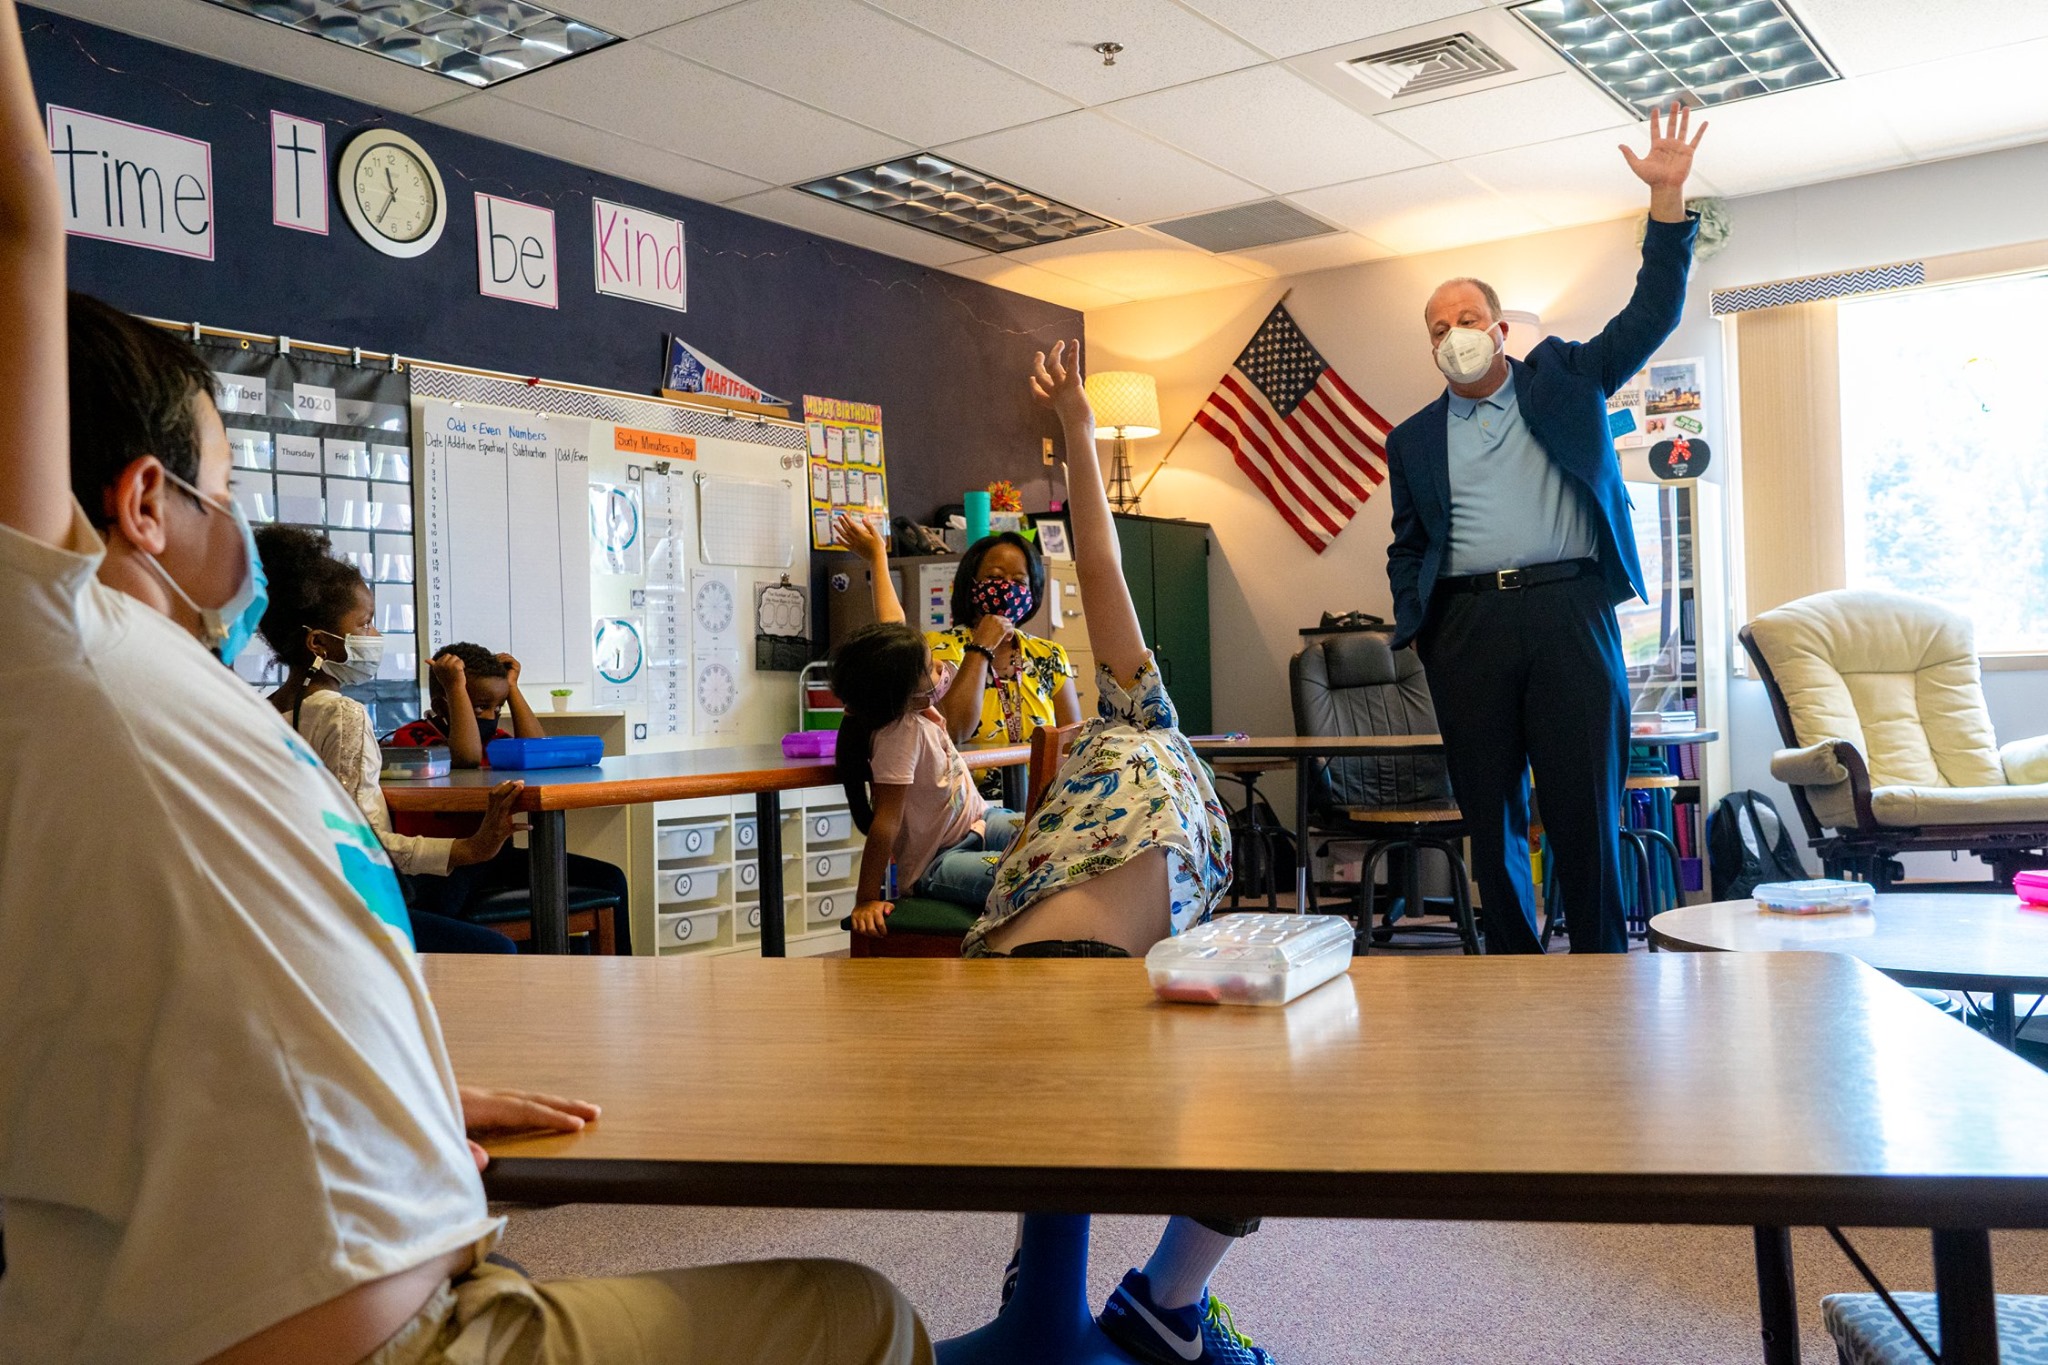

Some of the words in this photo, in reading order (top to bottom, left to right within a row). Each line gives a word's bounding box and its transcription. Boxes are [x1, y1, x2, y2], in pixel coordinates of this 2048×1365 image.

[373, 157, 380, 167] 11
[387, 155, 396, 165] 12
[364, 167, 373, 177] 10
[405, 164, 408, 173] 1
[414, 177, 419, 187] 2
[360, 184, 365, 193] 9
[420, 196, 425, 205] 3
[50, 125, 209, 235] time
[277, 124, 316, 219] t
[487, 197, 546, 289] be
[365, 202, 371, 211] 8
[391, 223, 397, 233] 6
[407, 221, 412, 231] 5
[704, 368, 761, 401] HARTFORD
[298, 396, 332, 412] 2020
[447, 417, 466, 433] Odd
[479, 422, 501, 436] Even
[508, 425, 547, 441] Numbers
[425, 431, 444, 448] Date
[448, 435, 476, 451] Addition
[478, 440, 506, 456] Equation
[641, 435, 670, 453] Minutes
[681, 441, 694, 460] Day
[282, 448, 315, 460] Thursday
[744, 831, 749, 839] 5
[692, 836, 697, 845] 4
[821, 862, 827, 870] 12
[747, 869, 752, 878] 11
[681, 880, 688, 889] 10
